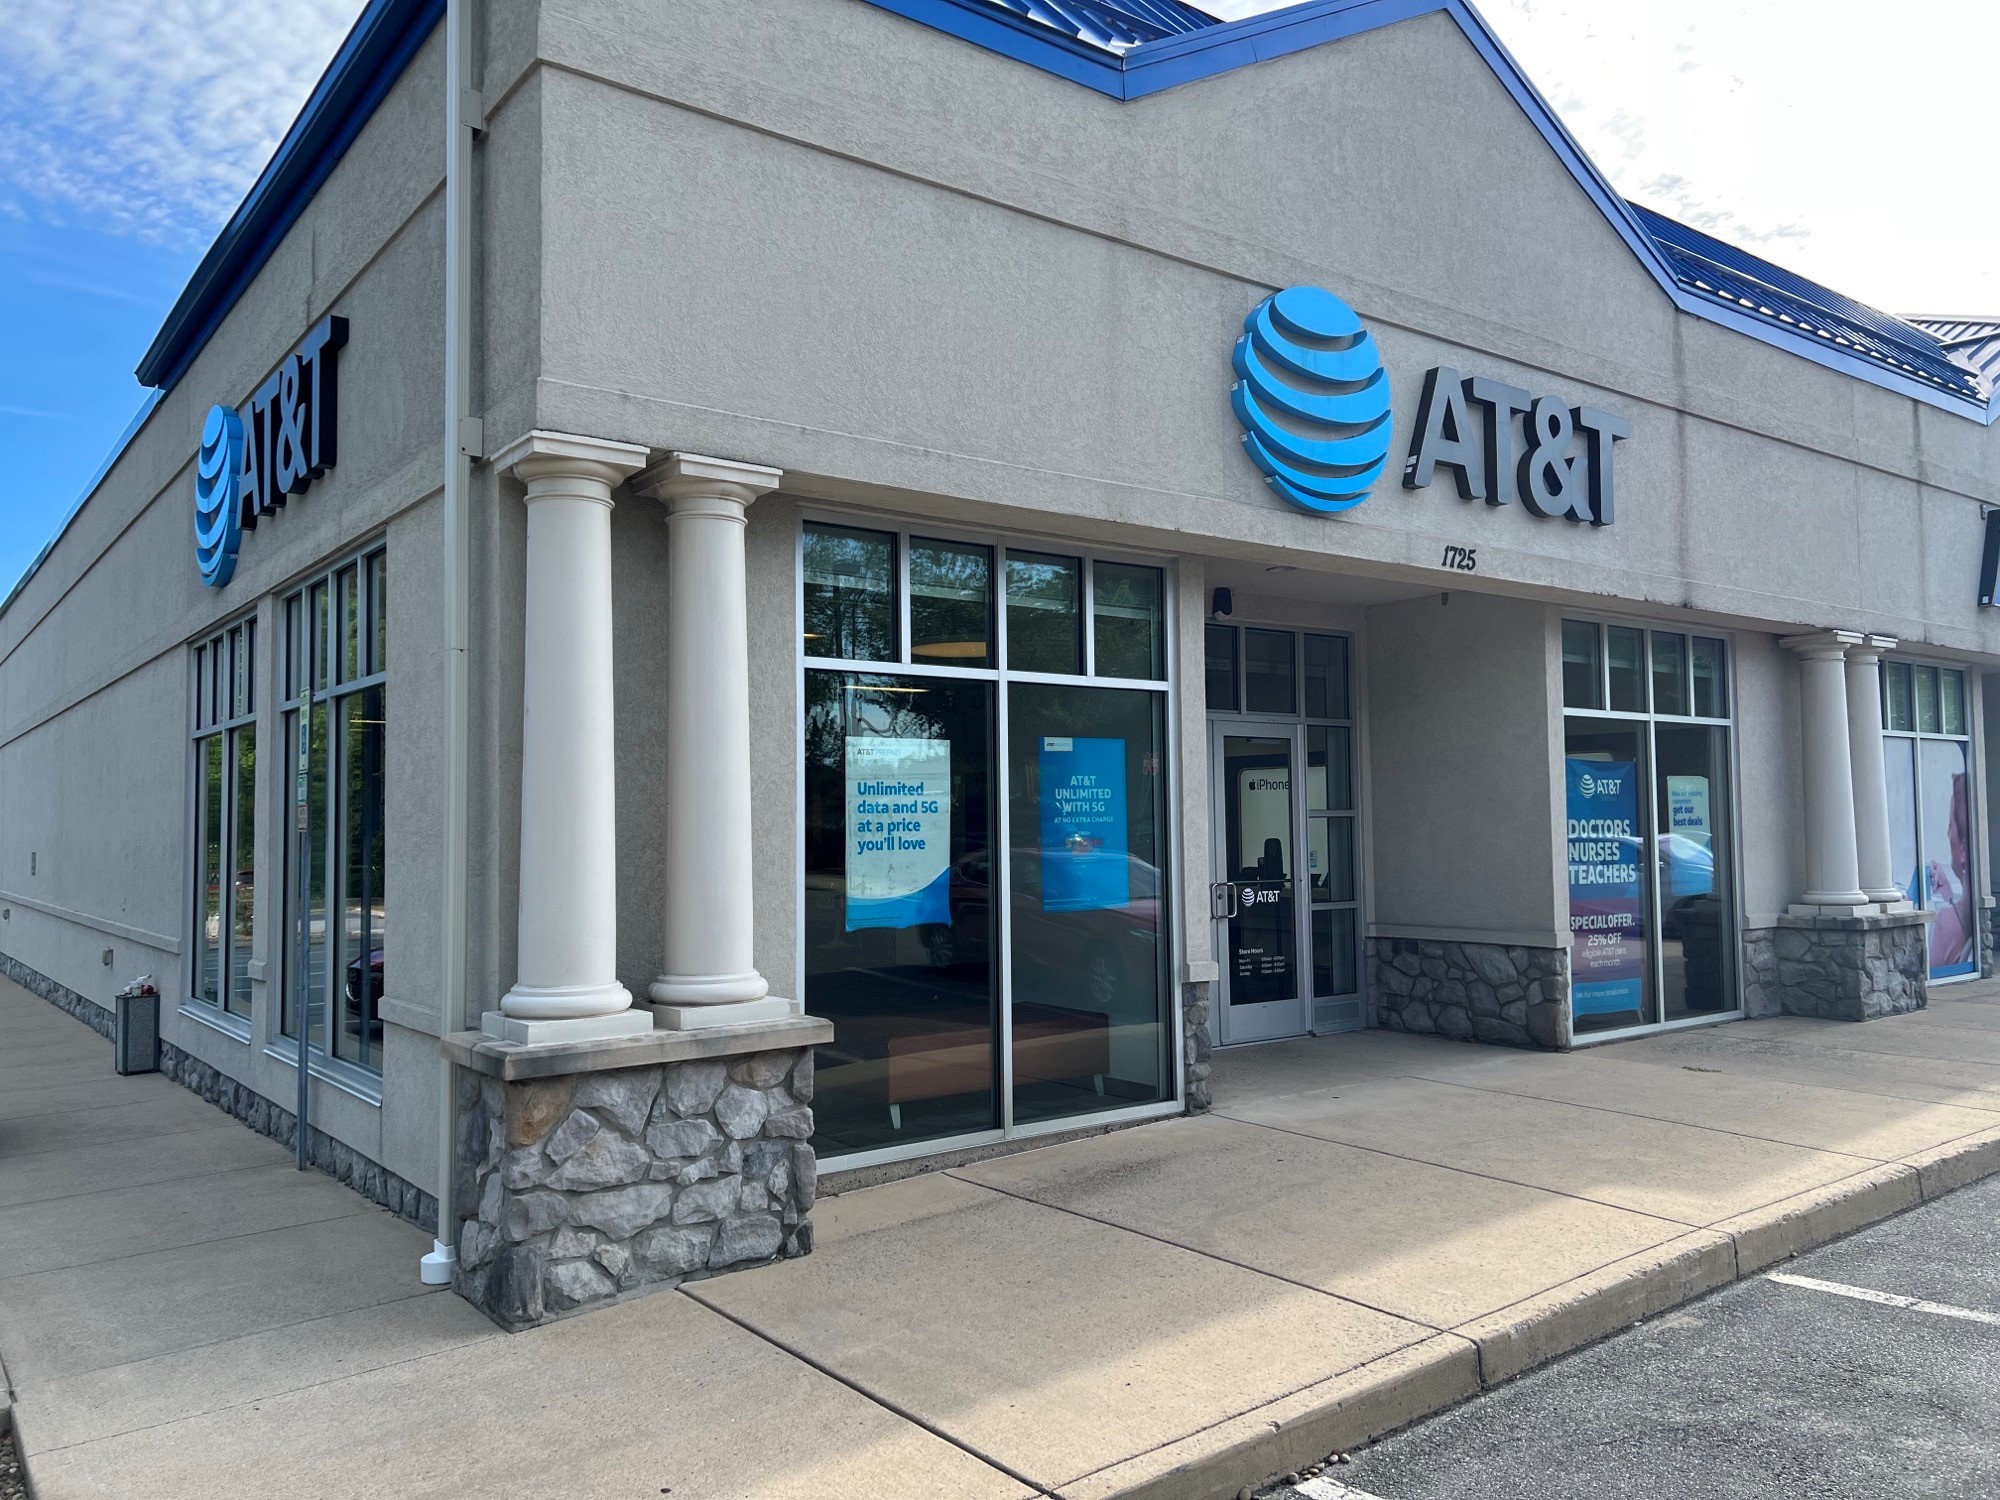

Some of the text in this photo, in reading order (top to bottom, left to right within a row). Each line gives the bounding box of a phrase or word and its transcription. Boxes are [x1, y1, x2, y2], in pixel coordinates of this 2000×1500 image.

[235, 314, 350, 532] AT&T
[1403, 365, 1632, 526] AT&T
[1440, 544, 1477, 572] 1725
[856, 748, 874, 756] AT&T
[1069, 775, 1097, 786] AT&T
[1256, 779, 1290, 791] iPhone
[1597, 779, 1621, 795] AT&T
[857, 781, 924, 796] Unlimited
[1055, 788, 1112, 799] UNLIMITED
[857, 799, 939, 814] data and 5G
[1062, 801, 1105, 813] WITH 5G
[1673, 805, 1694, 816] get our
[857, 817, 921, 836] at a price
[1568, 818, 1631, 839] DOCTORS
[1673, 816, 1703, 826] best deals
[857, 836, 926, 855] you'll love
[1568, 841, 1621, 862] NURSES
[1569, 863, 1637, 885] TEACHERS
[1256, 890, 1280, 903] AT&T
[1570, 913, 1636, 930] SPECIAL OFFER.
[1587, 932, 1622, 946] 25% OFF
[1581, 948, 1602, 960] eligible
[1602, 947, 1615, 956] AT&T
[1589, 960, 1604, 968] each
